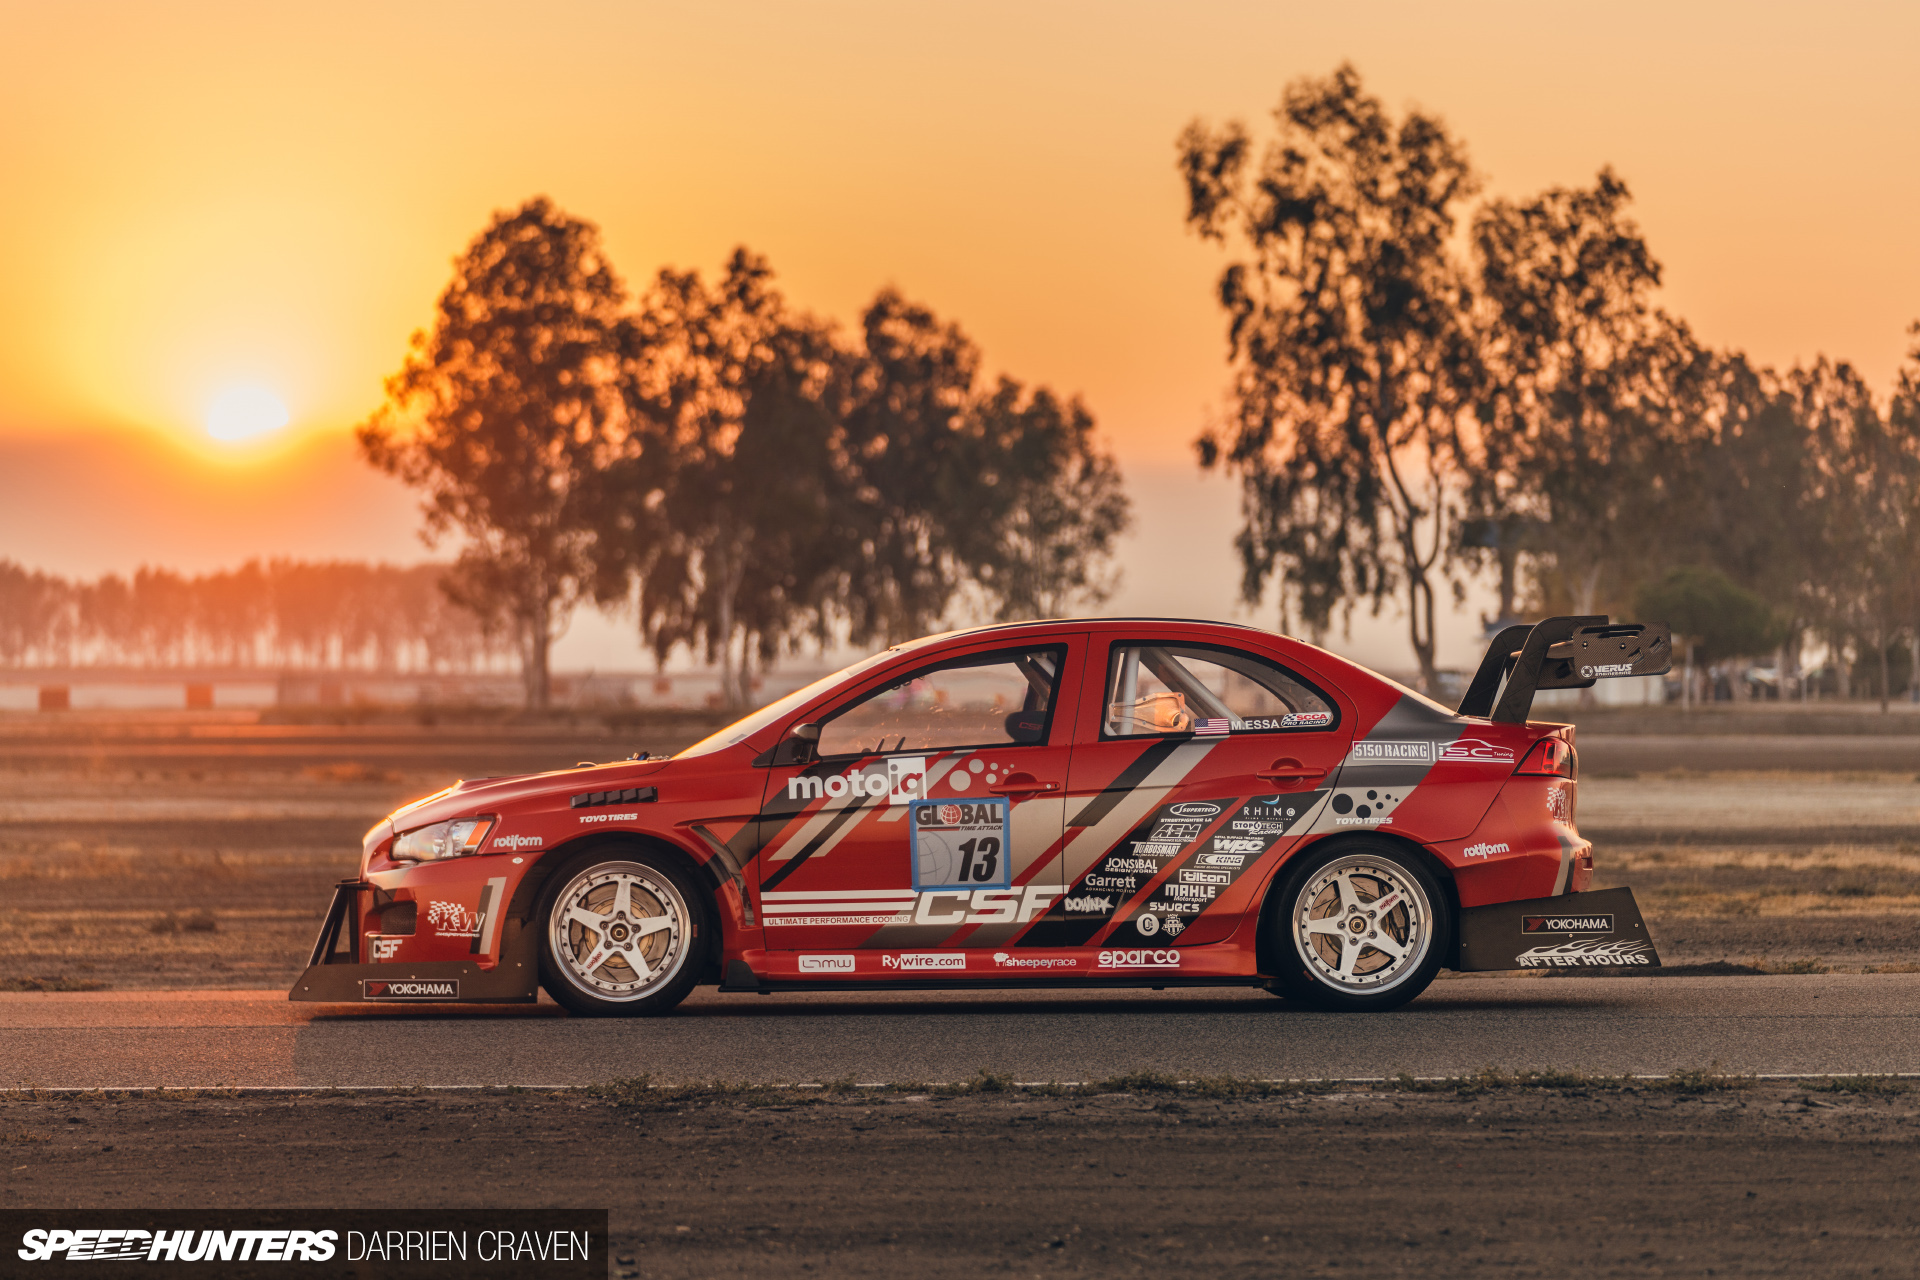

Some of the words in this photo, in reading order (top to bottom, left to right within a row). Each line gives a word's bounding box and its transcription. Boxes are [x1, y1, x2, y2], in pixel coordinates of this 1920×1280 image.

[1593, 664, 1633, 673] VERUS
[1297, 713, 1327, 721] SCCA
[1231, 719, 1280, 730] M.ESSA
[1355, 744, 1381, 758] 5150
[1384, 743, 1428, 758] RACING
[579, 815, 607, 823] TOYO
[608, 813, 638, 822] TIRES
[916, 803, 1003, 826] GLOBAL
[1150, 823, 1202, 839] AEM
[493, 834, 543, 851] rotiform
[1130, 841, 1182, 855] TURBOSMART
[1463, 842, 1510, 859] rotiform
[958, 836, 1001, 882] 13
[1215, 856, 1242, 864] KING
[1085, 873, 1136, 888] Garrett
[1183, 872, 1227, 883] tilton
[1165, 884, 1215, 898] MAHLE
[915, 885, 1070, 925] CSF
[1173, 895, 1208, 903] Motorsport
[769, 917, 808, 926] ULTIMATE
[809, 916, 870, 925] PERFORMANCE
[872, 915, 909, 924] COOLING
[1545, 918, 1609, 930] YOKOHAMA
[373, 939, 403, 958] CSF
[882, 954, 964, 970] Rywire.com
[1006, 957, 1077, 969] sheepeyrace
[1098, 950, 1181, 968] sparco
[1519, 955, 1580, 967] AFTER
[1580, 954, 1650, 966] HOURS
[388, 983, 454, 995] YOKOHAMA
